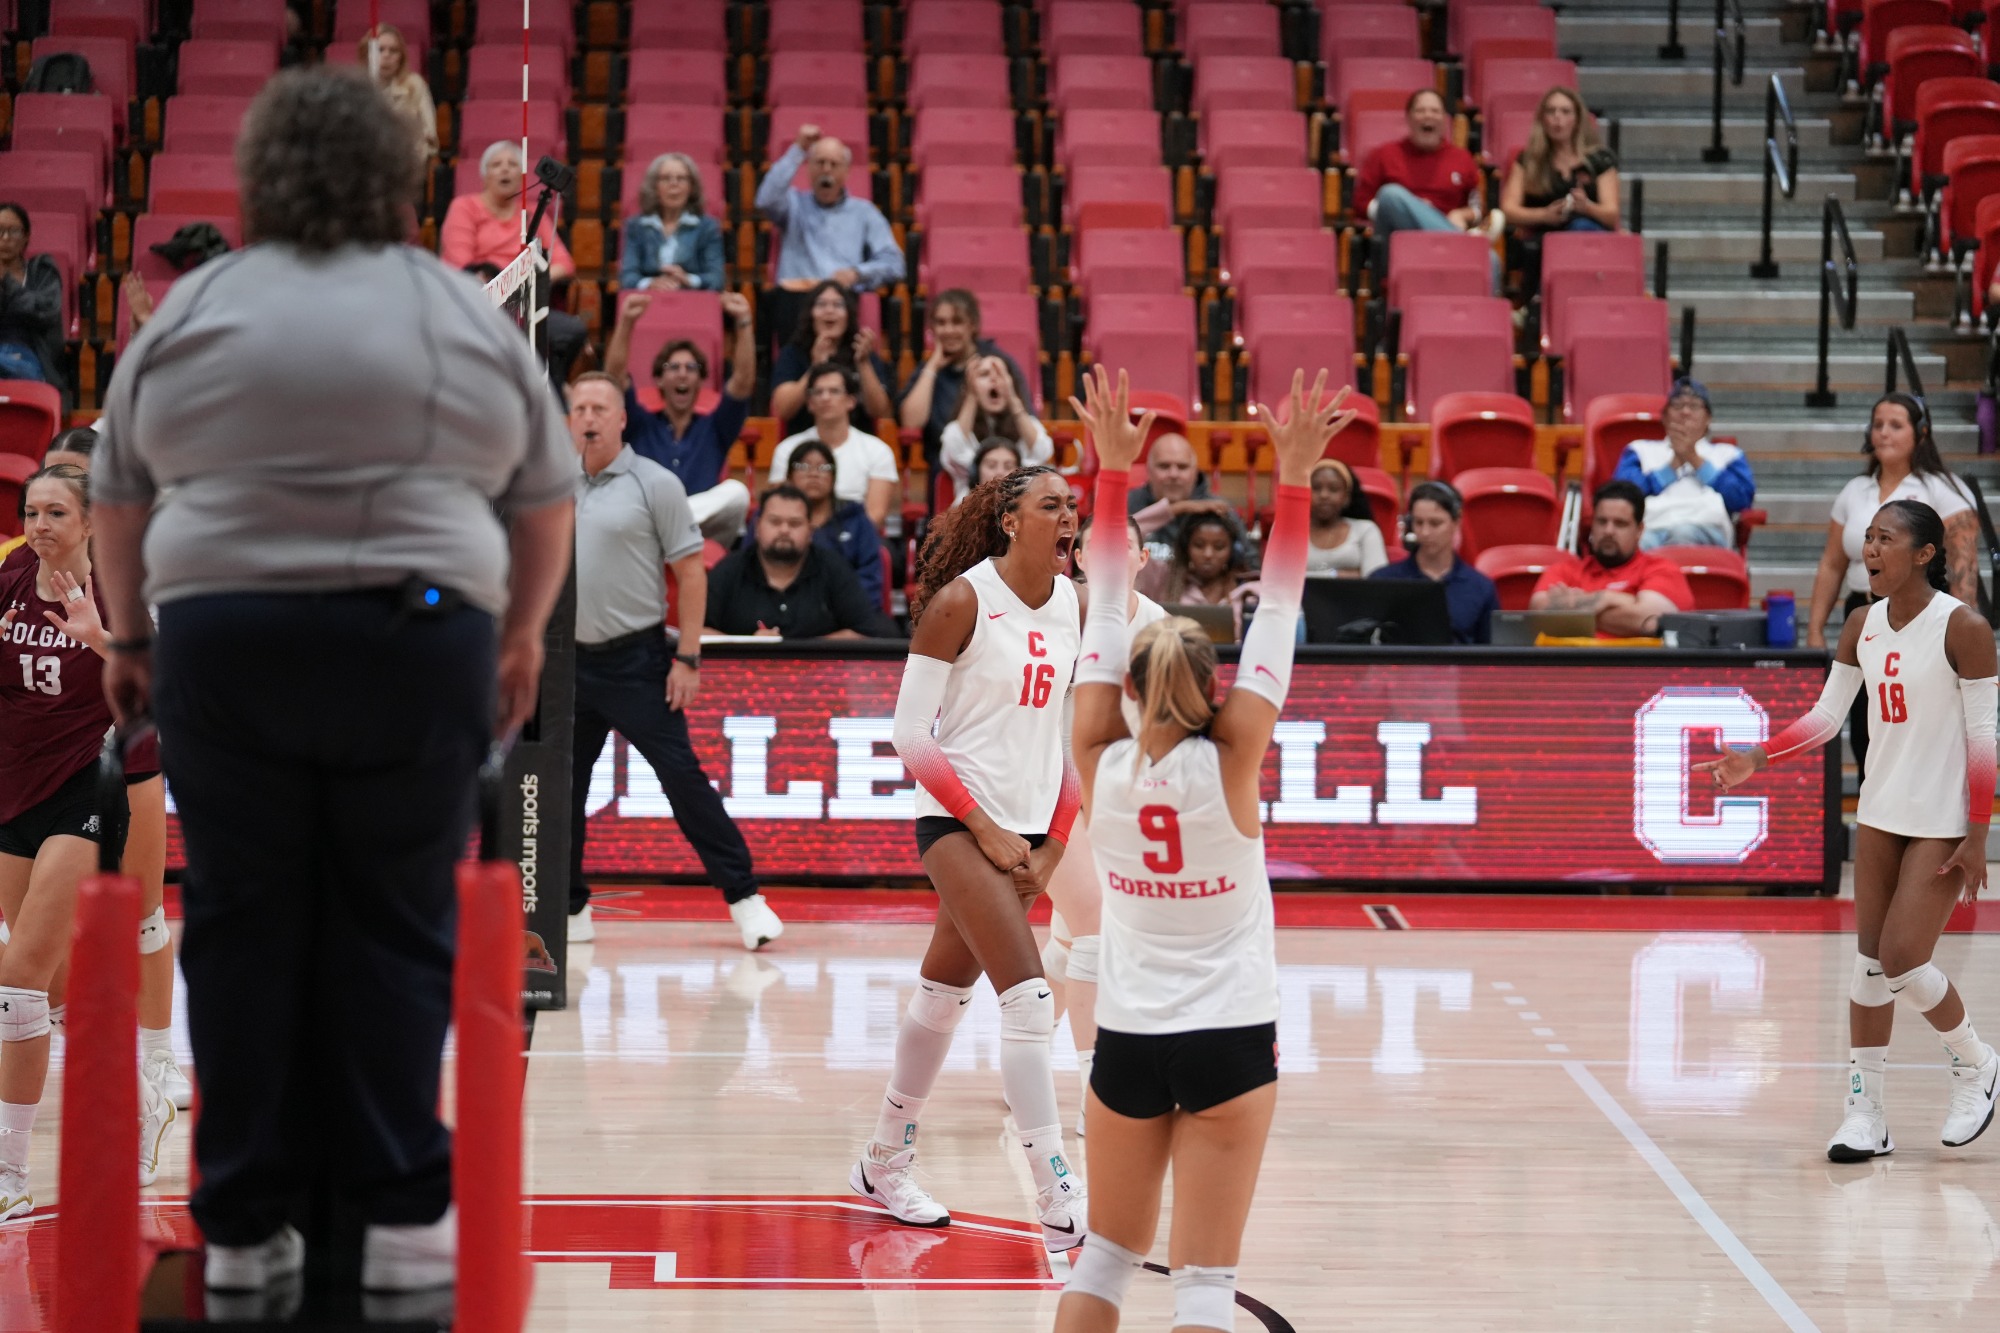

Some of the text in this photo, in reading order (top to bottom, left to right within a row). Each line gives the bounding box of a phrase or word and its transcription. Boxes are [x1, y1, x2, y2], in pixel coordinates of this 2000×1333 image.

[2, 622, 90, 650] COLGA
[1028, 631, 1047, 658] C
[19, 654, 62, 696] 13
[1884, 652, 1900, 677] C
[1018, 664, 1056, 709] 16
[1878, 682, 1908, 724] 18
[1633, 686, 1768, 863] C
[519, 774, 540, 914] sports imports
[1138, 804, 1184, 874] 9
[1108, 871, 1236, 899] CORNELL
